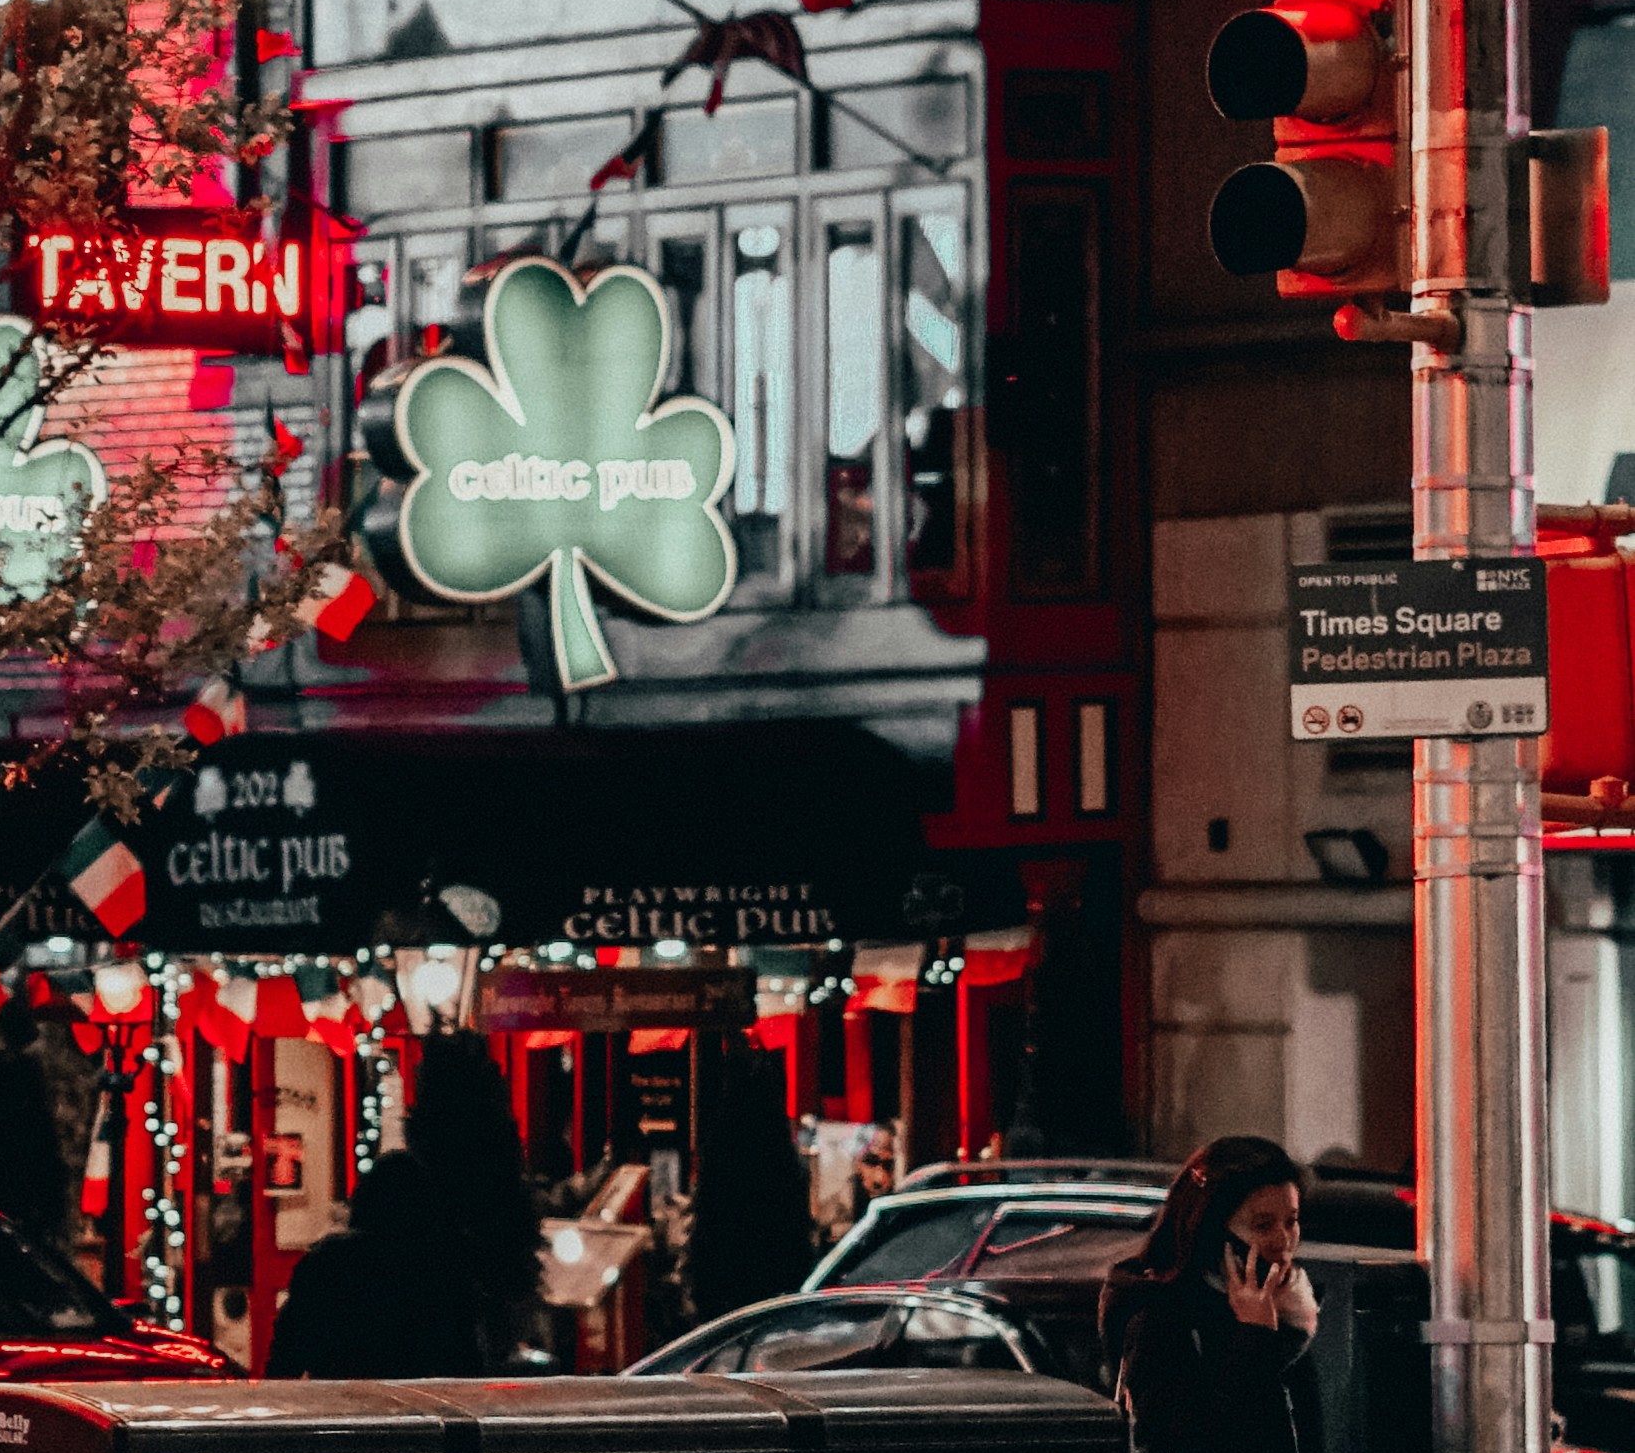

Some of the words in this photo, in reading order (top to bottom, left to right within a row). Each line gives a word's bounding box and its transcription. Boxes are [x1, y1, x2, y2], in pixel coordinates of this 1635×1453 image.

[28, 233, 300, 316] TAVERN
[1298, 575, 1333, 588] OPEN
[1335, 575, 1351, 587] TO
[1353, 573, 1399, 586] PUBLIC
[1496, 568, 1531, 583] NYC
[1299, 608, 1390, 637] Times
[1394, 606, 1503, 639] Square
[1301, 644, 1452, 672] Pedestrian
[1457, 642, 1533, 667] Plaza
